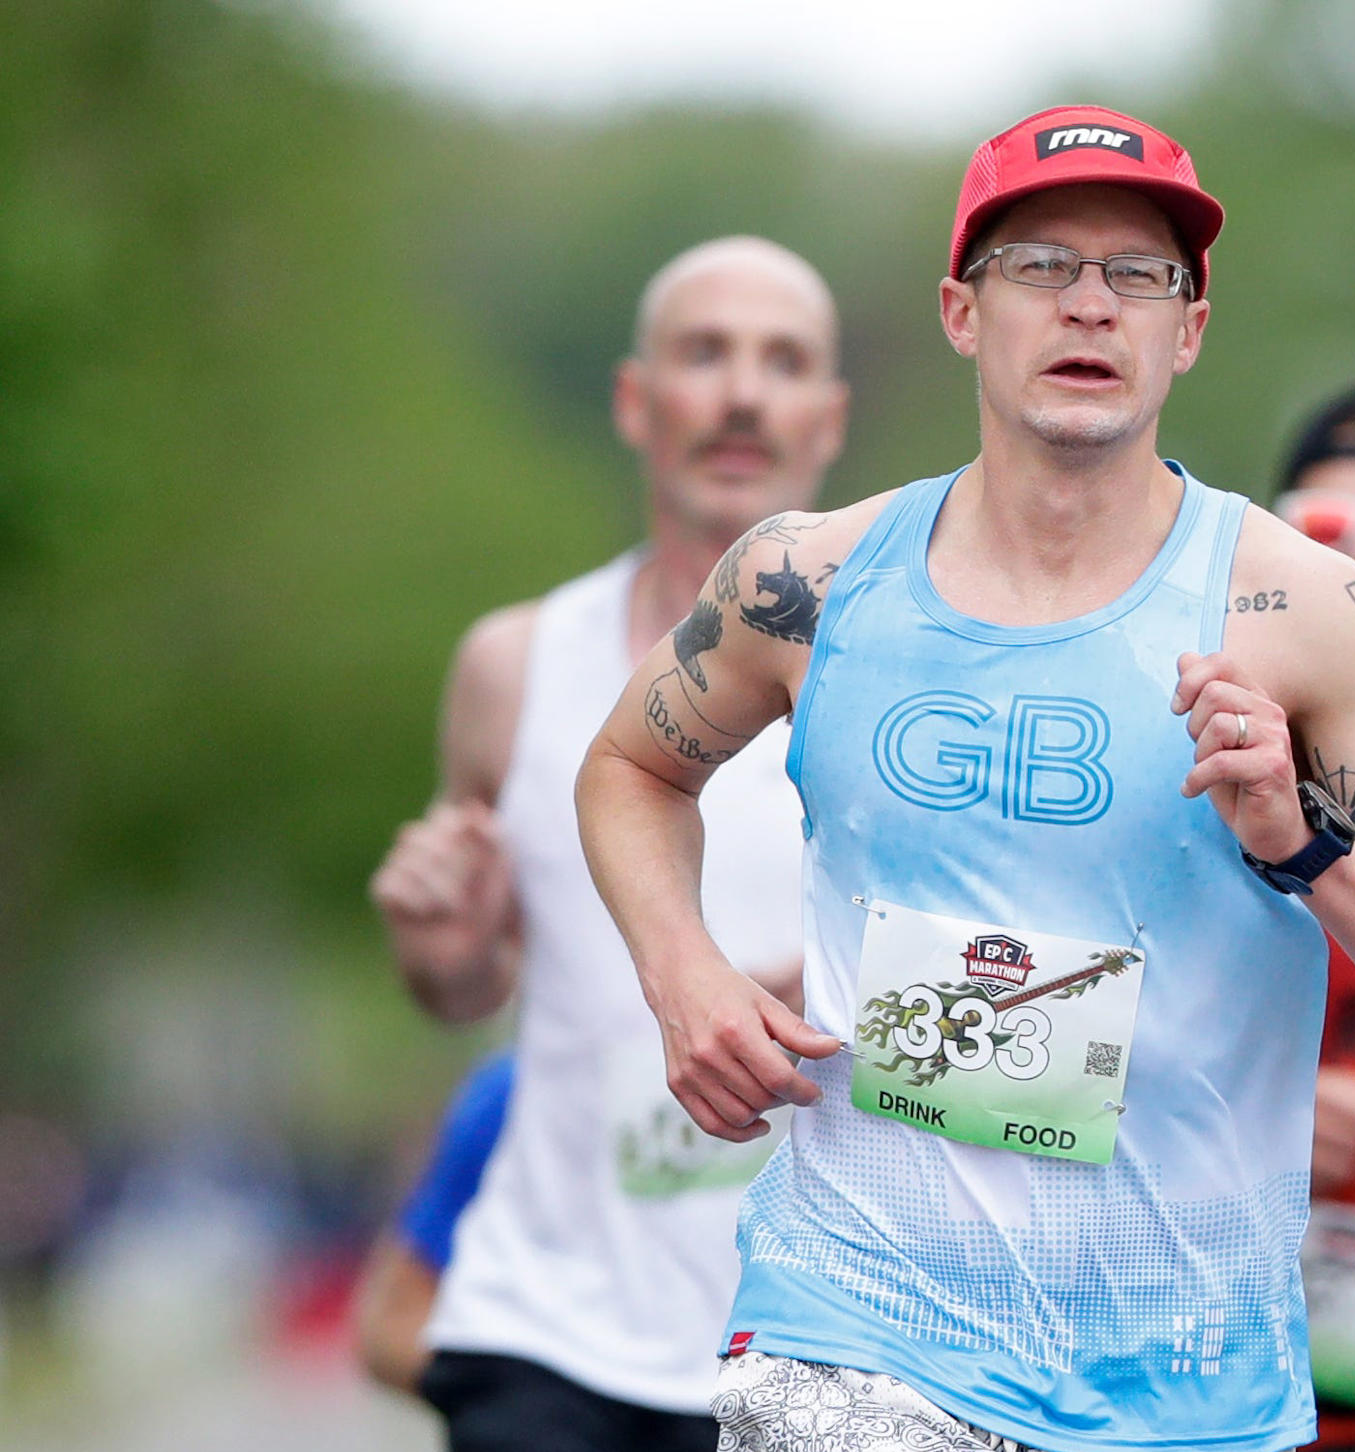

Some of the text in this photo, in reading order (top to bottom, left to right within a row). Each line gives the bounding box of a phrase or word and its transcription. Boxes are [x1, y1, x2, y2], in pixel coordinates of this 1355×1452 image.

[1227, 589, 1288, 614] 982
[872, 689, 1115, 826] GB
[969, 960, 1026, 982] MARATHON
[892, 984, 1052, 1081] 333
[878, 1091, 1077, 1151] DRINK FOOD
